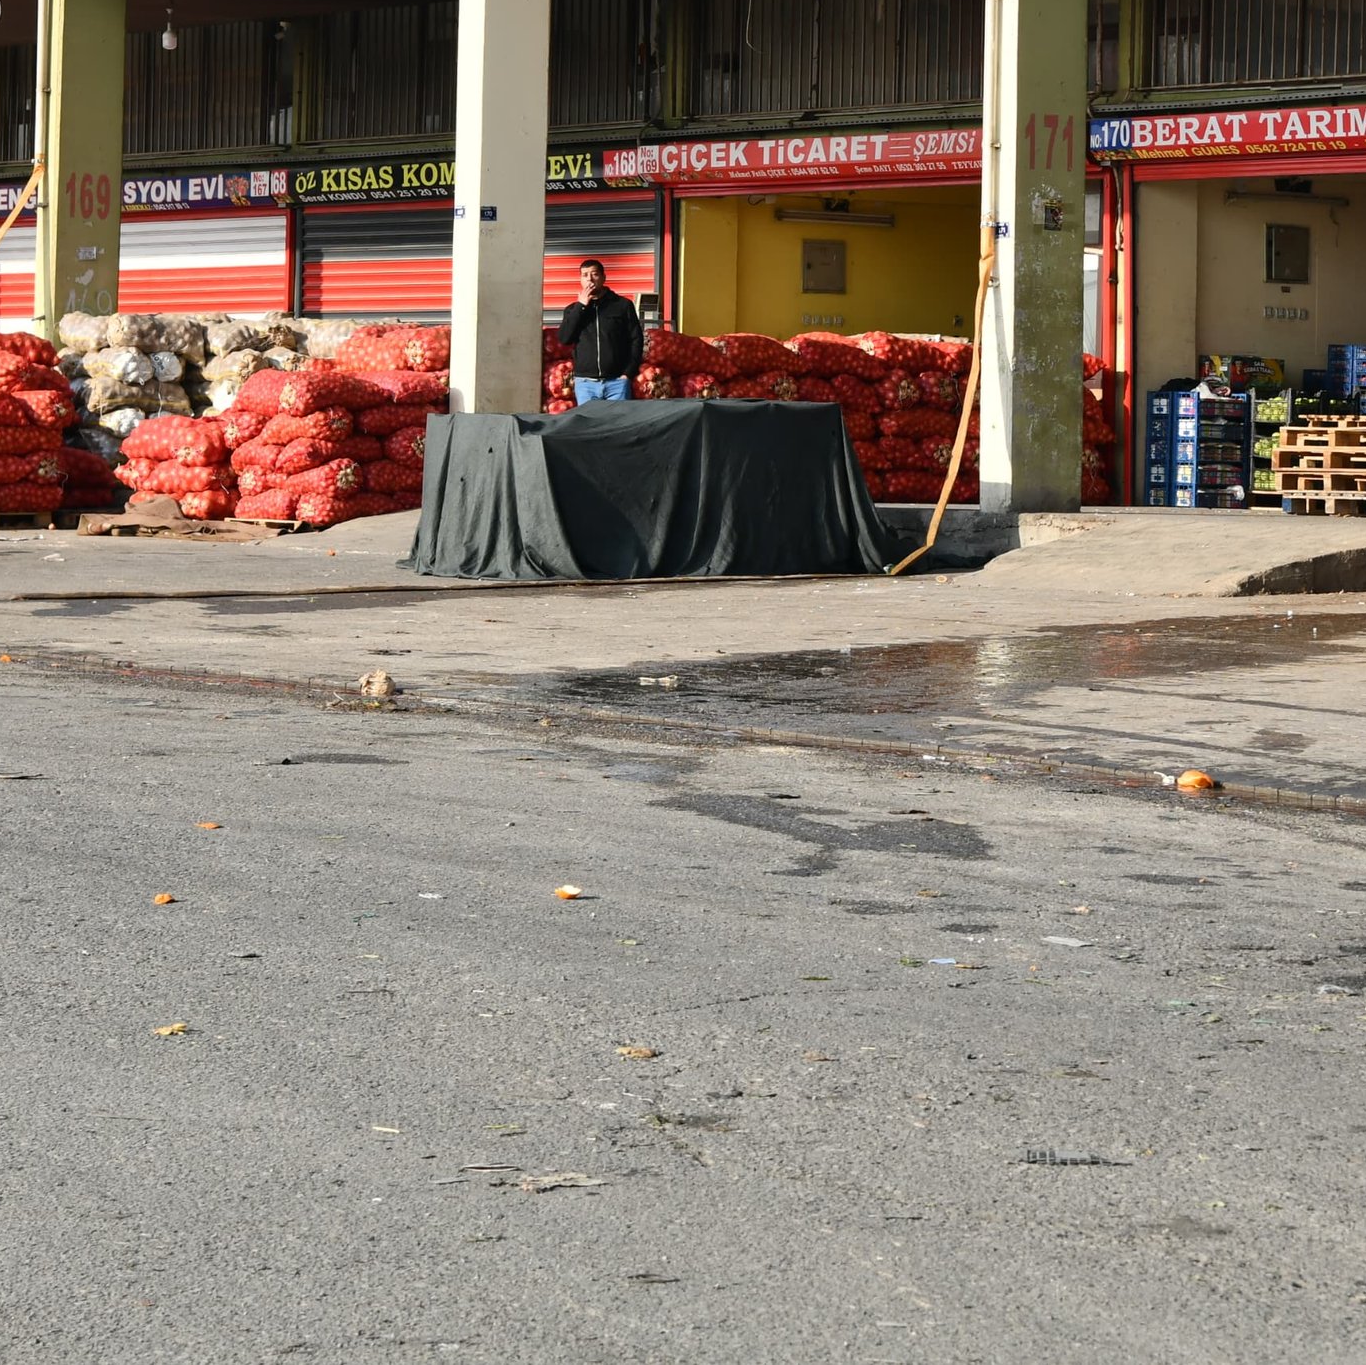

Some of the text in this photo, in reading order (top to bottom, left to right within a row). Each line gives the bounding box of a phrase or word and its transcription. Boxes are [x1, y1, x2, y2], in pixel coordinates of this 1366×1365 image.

[1131, 113, 1248, 148] BERAT
[640, 147, 654, 158] No:
[1025, 113, 1074, 172] 171
[1136, 148, 1186, 160] Mehmet
[1245, 143, 1280, 155] 0542
[1280, 142, 1306, 153] 724
[1307, 141, 1326, 151] 76
[1330, 140, 1347, 150] 19
[640, 159, 657, 173] 169
[253, 172, 265, 182] No:
[295, 170, 317, 194] ÖZ
[321, 165, 394, 192] KISAS
[66, 172, 111, 220] 169
[253, 183, 267, 196] 167
[329, 191, 367, 202] KONDU
[370, 190, 395, 200] 0541
[397, 188, 416, 198] 251
[419, 188, 433, 197] 20
[434, 187, 448, 196] 78
[567, 181, 582, 189] 16
[583, 180, 598, 188] 60
